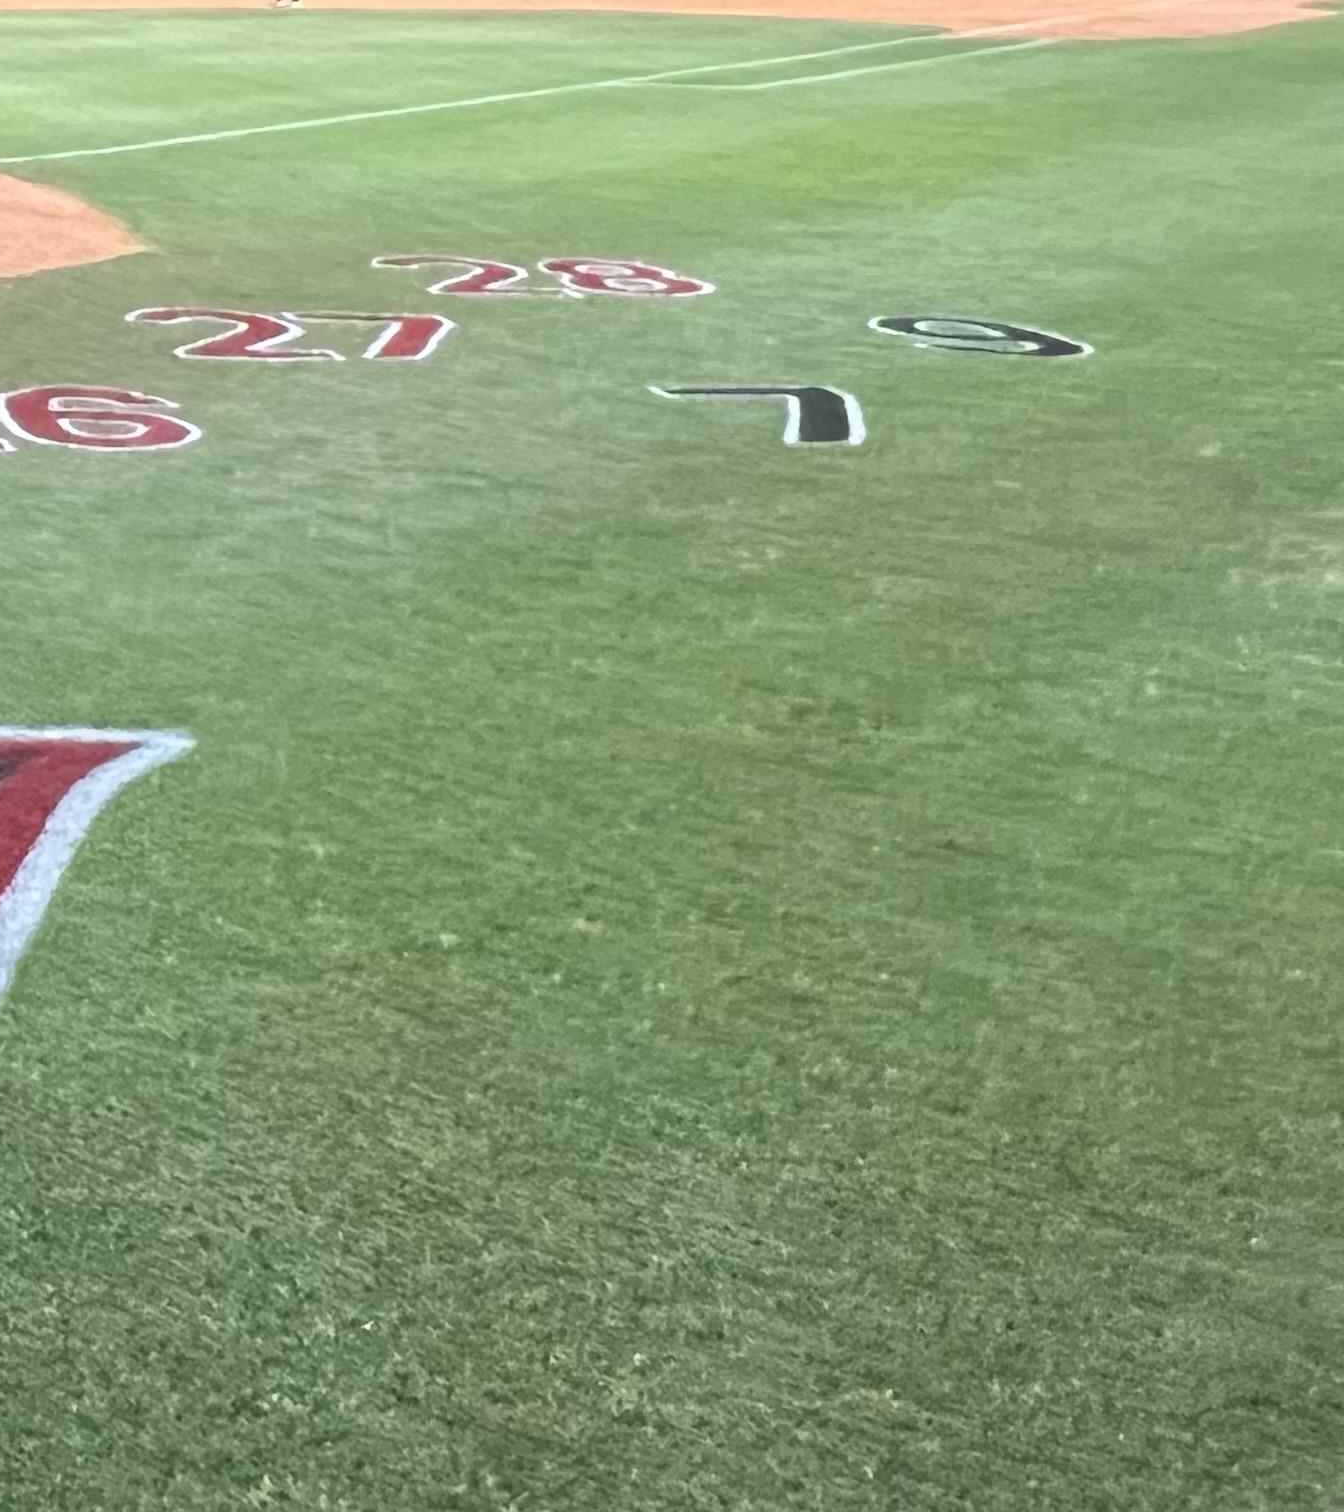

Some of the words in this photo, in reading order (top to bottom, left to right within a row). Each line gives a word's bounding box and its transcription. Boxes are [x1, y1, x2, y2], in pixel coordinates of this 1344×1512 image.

[371, 256, 716, 298] 28
[125, 307, 458, 361] 27
[867, 315, 1095, 358] 9
[647, 386, 867, 446] 7
